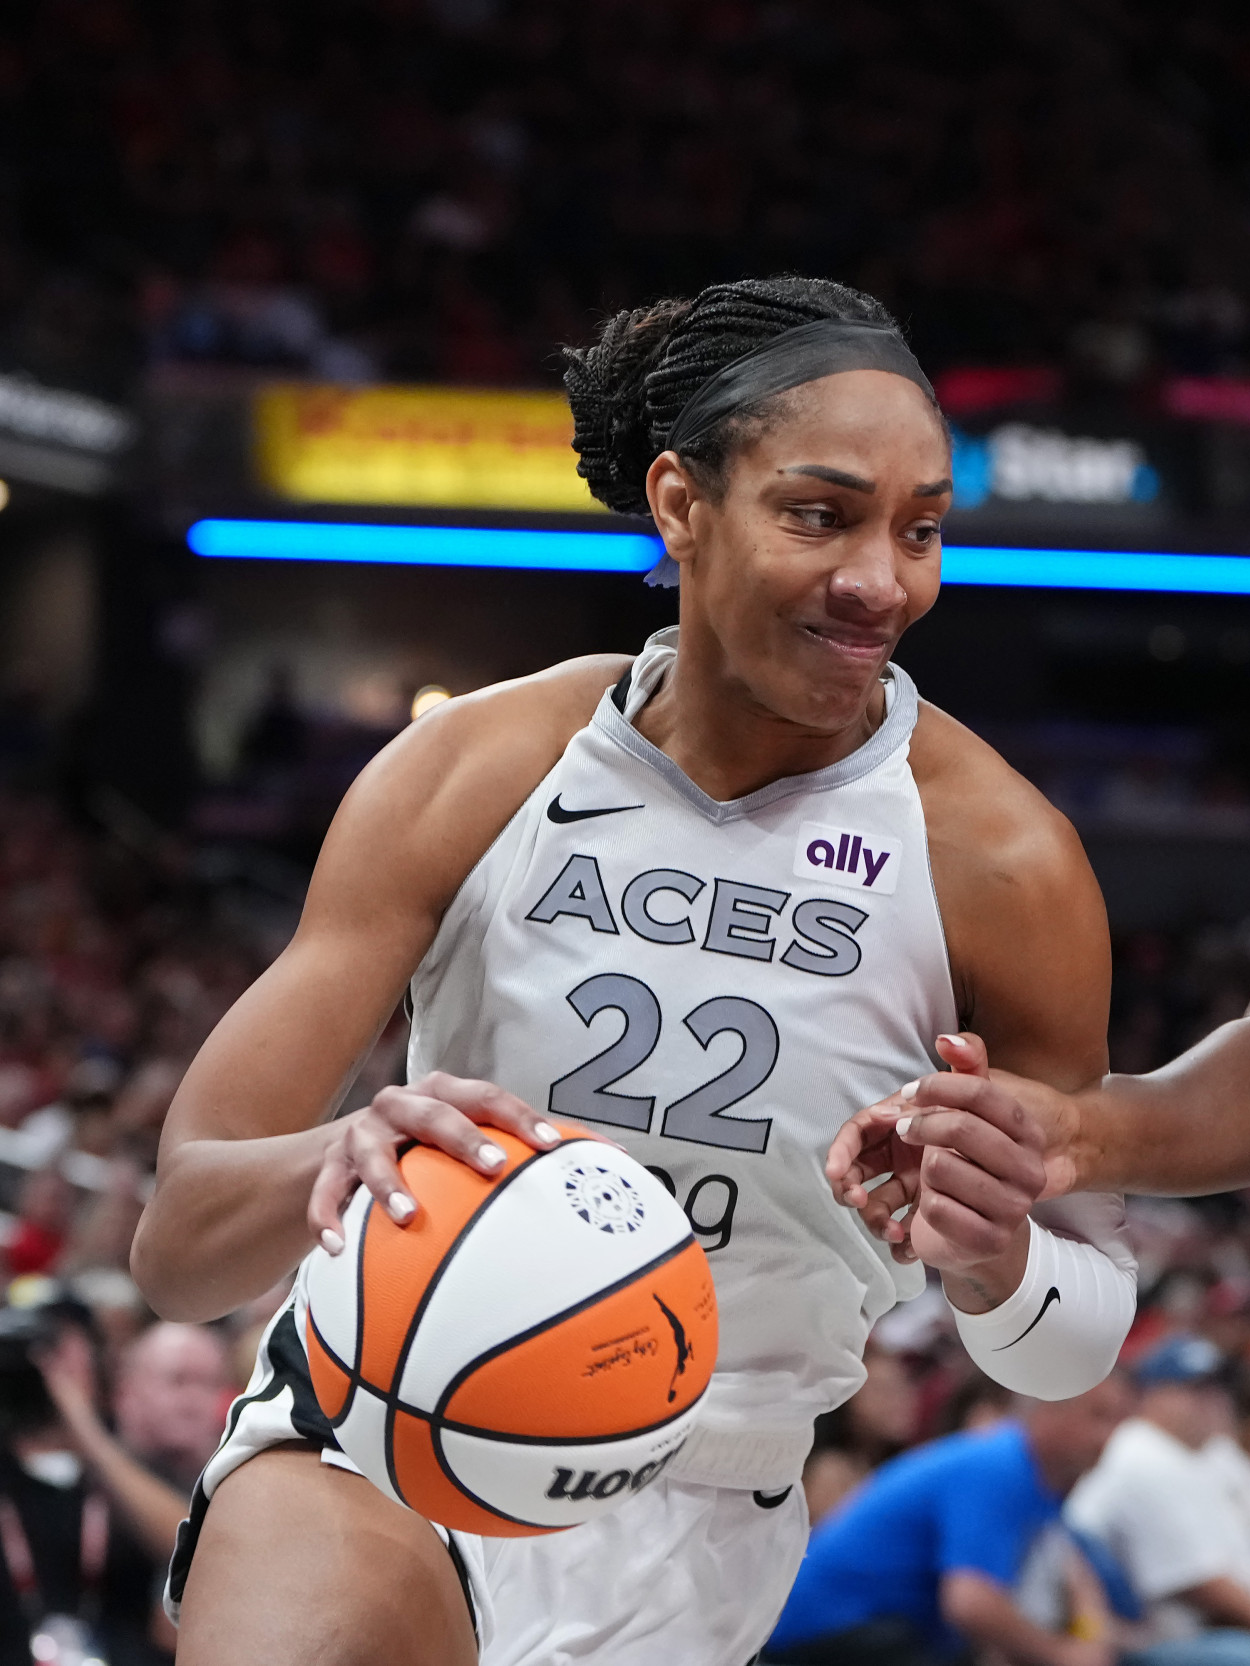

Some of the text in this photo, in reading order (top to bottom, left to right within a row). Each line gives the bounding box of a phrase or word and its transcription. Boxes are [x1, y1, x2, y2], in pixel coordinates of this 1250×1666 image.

[524, 853, 870, 977] ACES
[805, 833, 891, 887] ally
[548, 972, 781, 1155] 22
